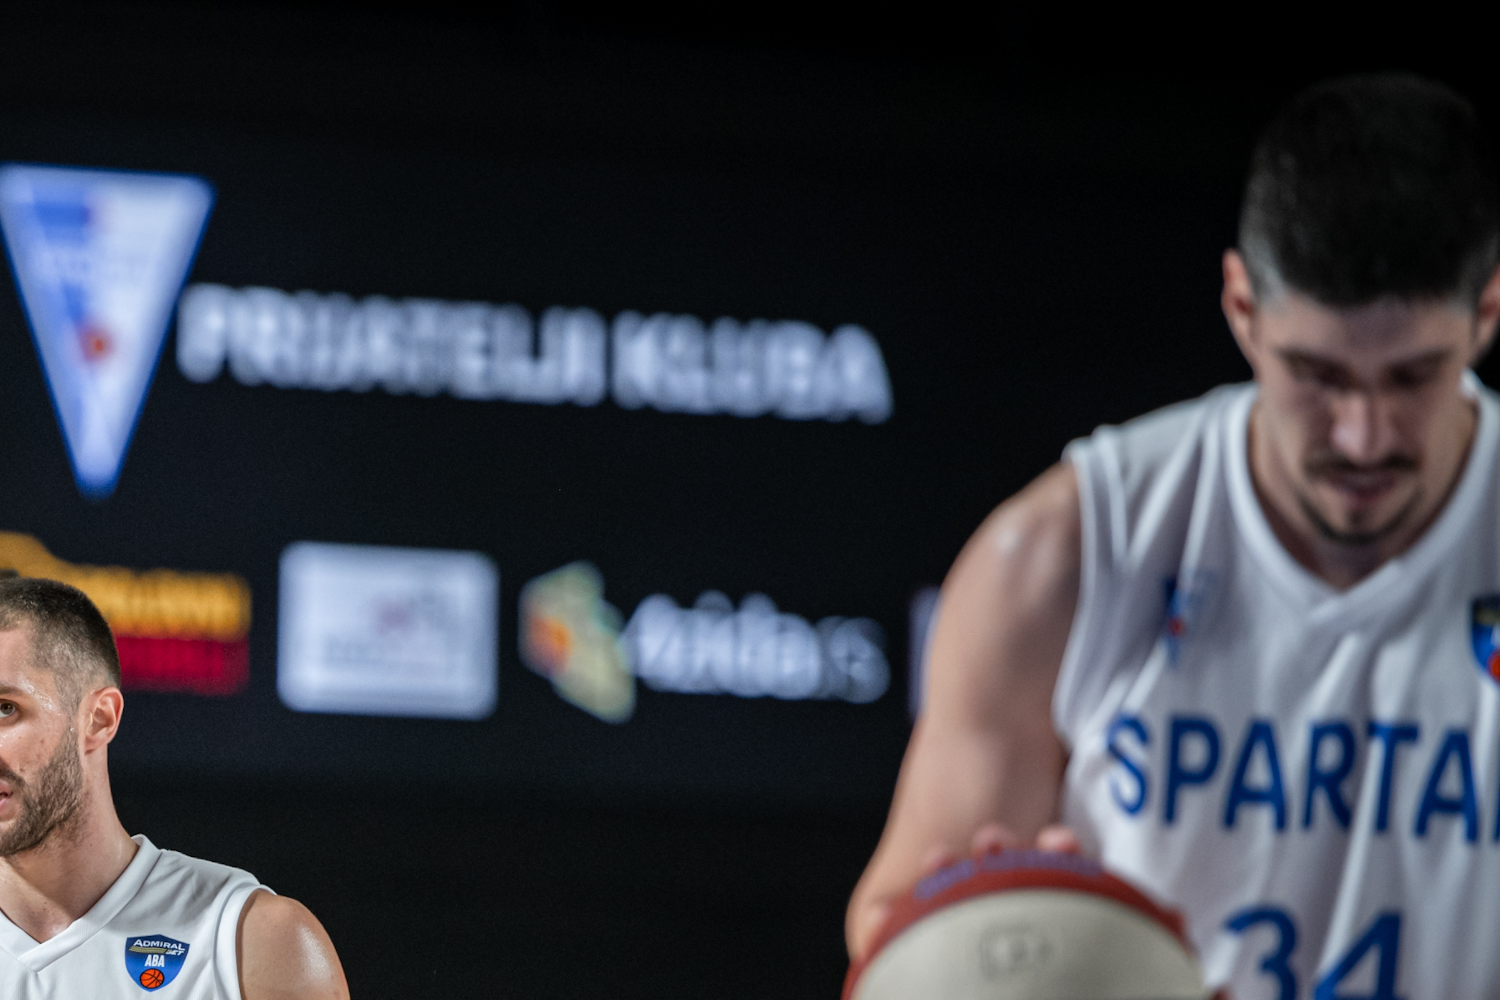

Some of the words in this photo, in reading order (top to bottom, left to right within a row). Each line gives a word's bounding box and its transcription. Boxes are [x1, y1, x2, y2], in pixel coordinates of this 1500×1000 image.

[613, 308, 893, 424] KLUBA
[1106, 713, 1500, 846] SPARTA
[133, 939, 186, 951] ADMIRAL
[144, 954, 165, 968] ABA
